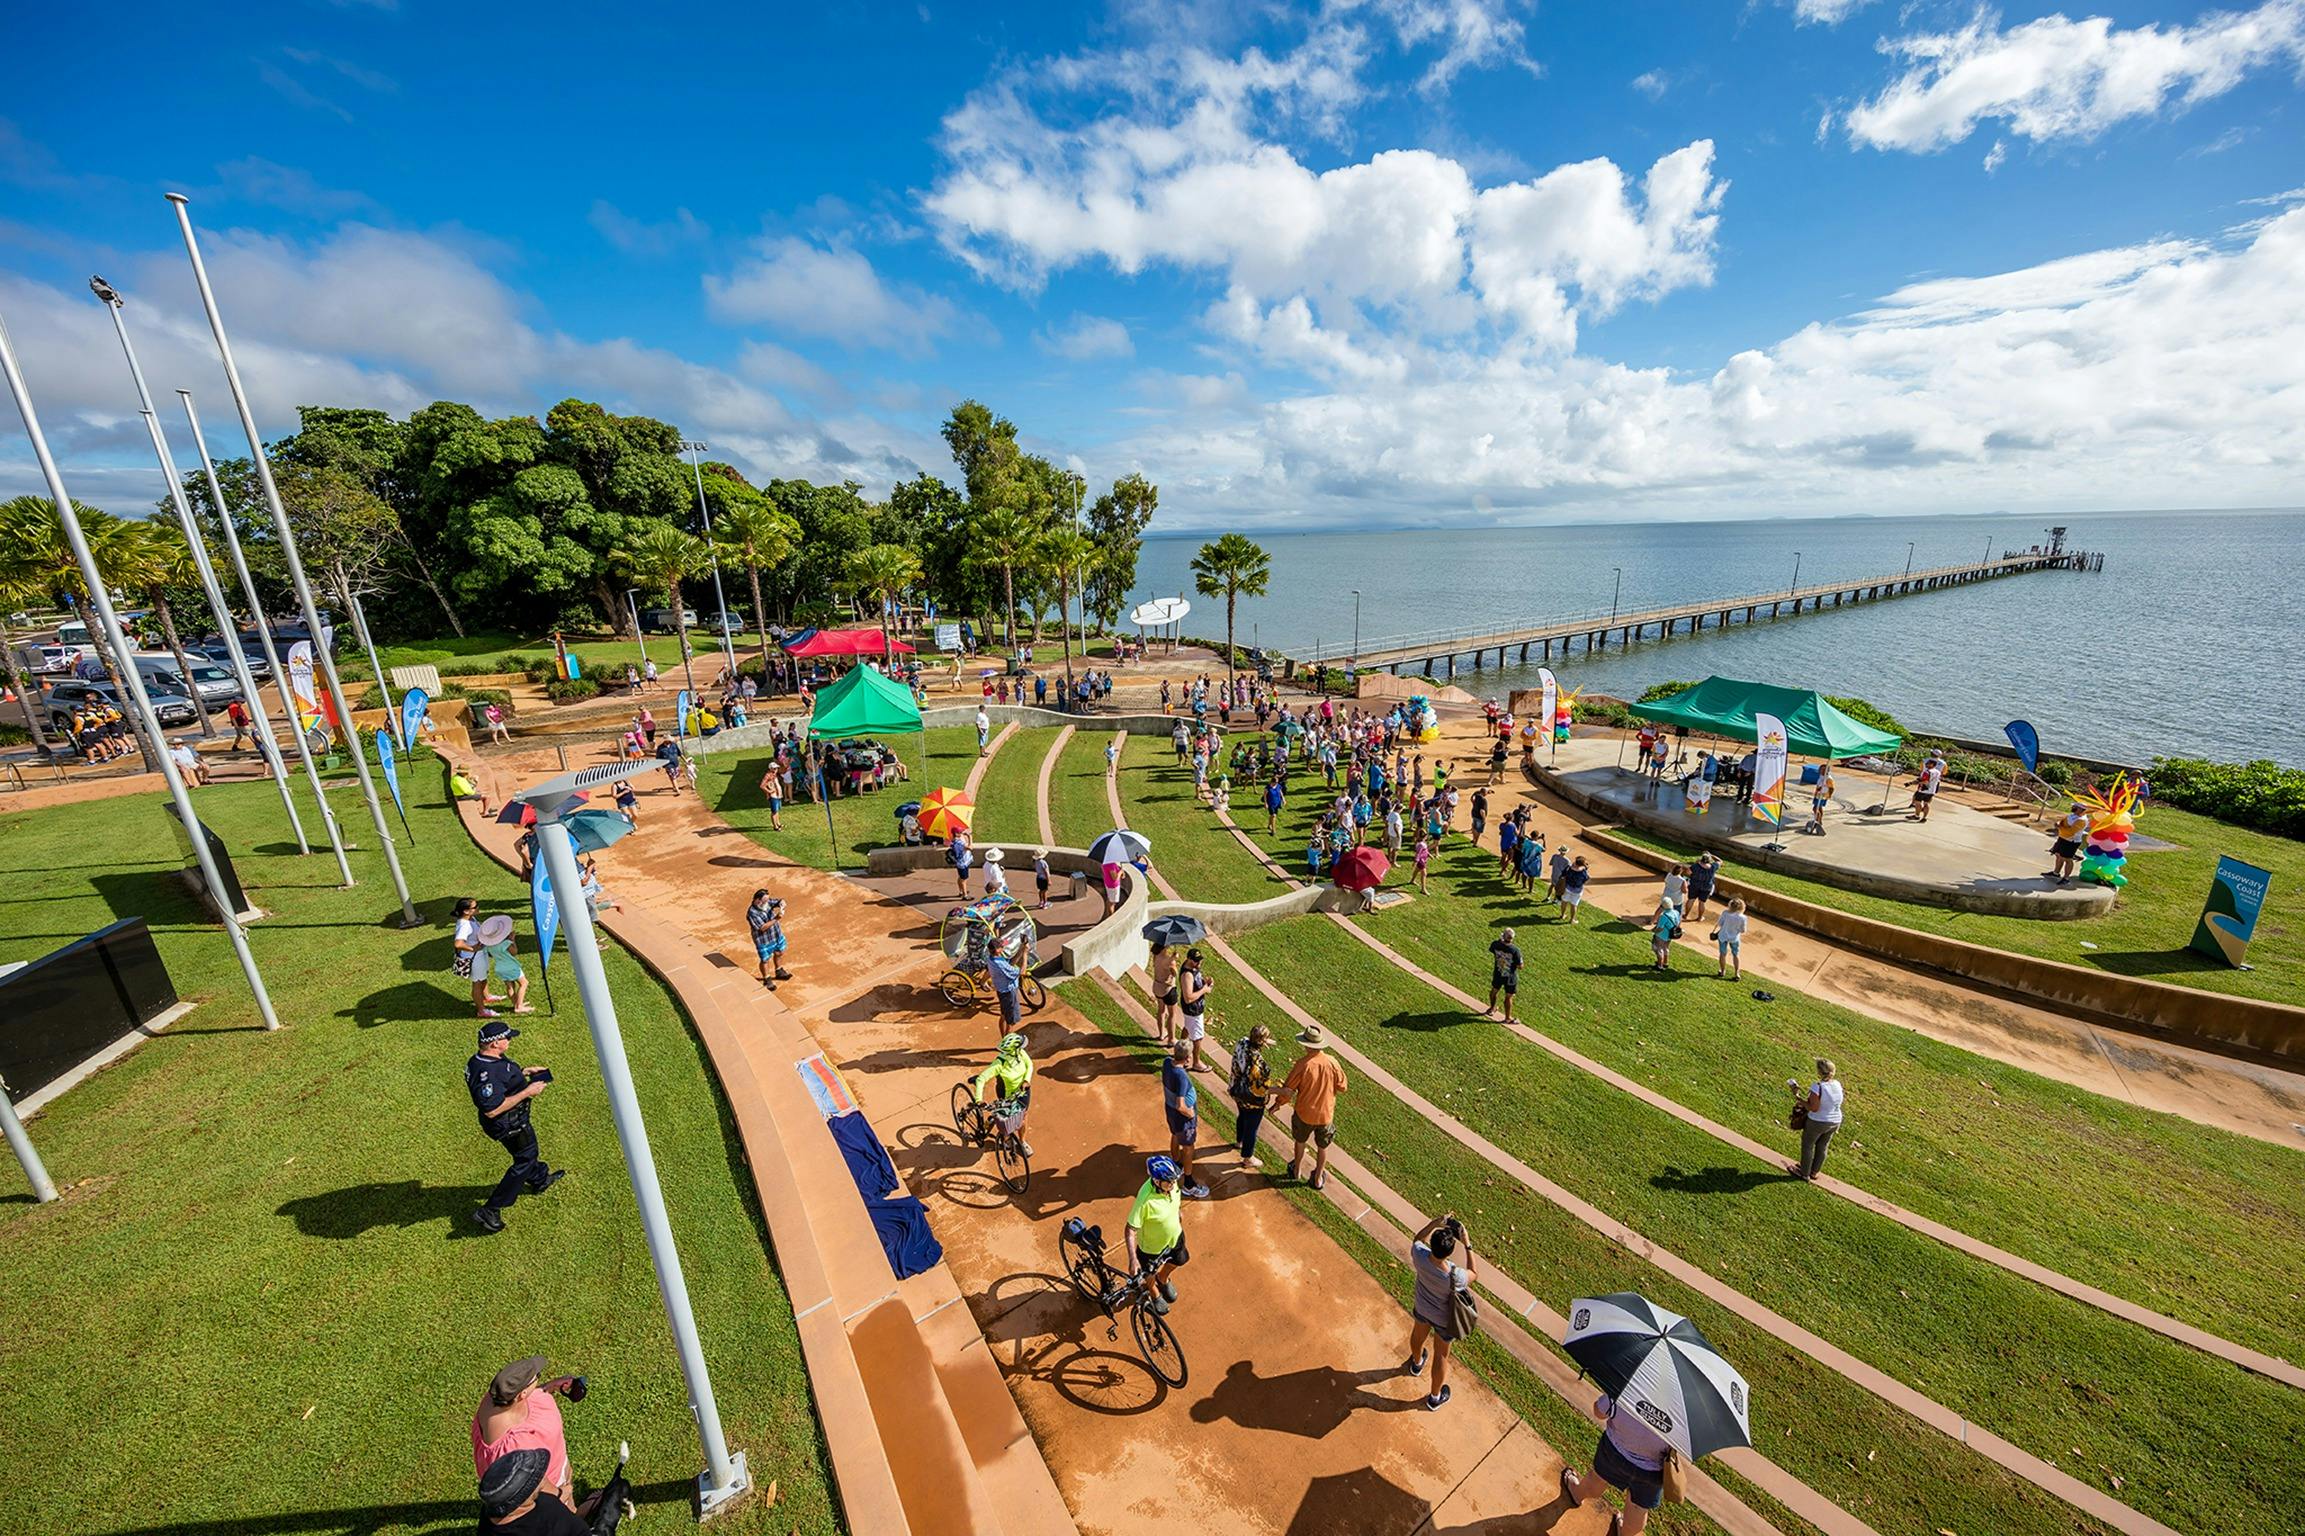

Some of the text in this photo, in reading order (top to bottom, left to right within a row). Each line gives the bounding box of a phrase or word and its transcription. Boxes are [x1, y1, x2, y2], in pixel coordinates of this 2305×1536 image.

[2217, 867, 2264, 890] Cassowary
[2236, 883, 2261, 898] Coast
[1640, 1410, 1668, 1433] SUGAR
[1642, 1402, 1668, 1421] TULLY
